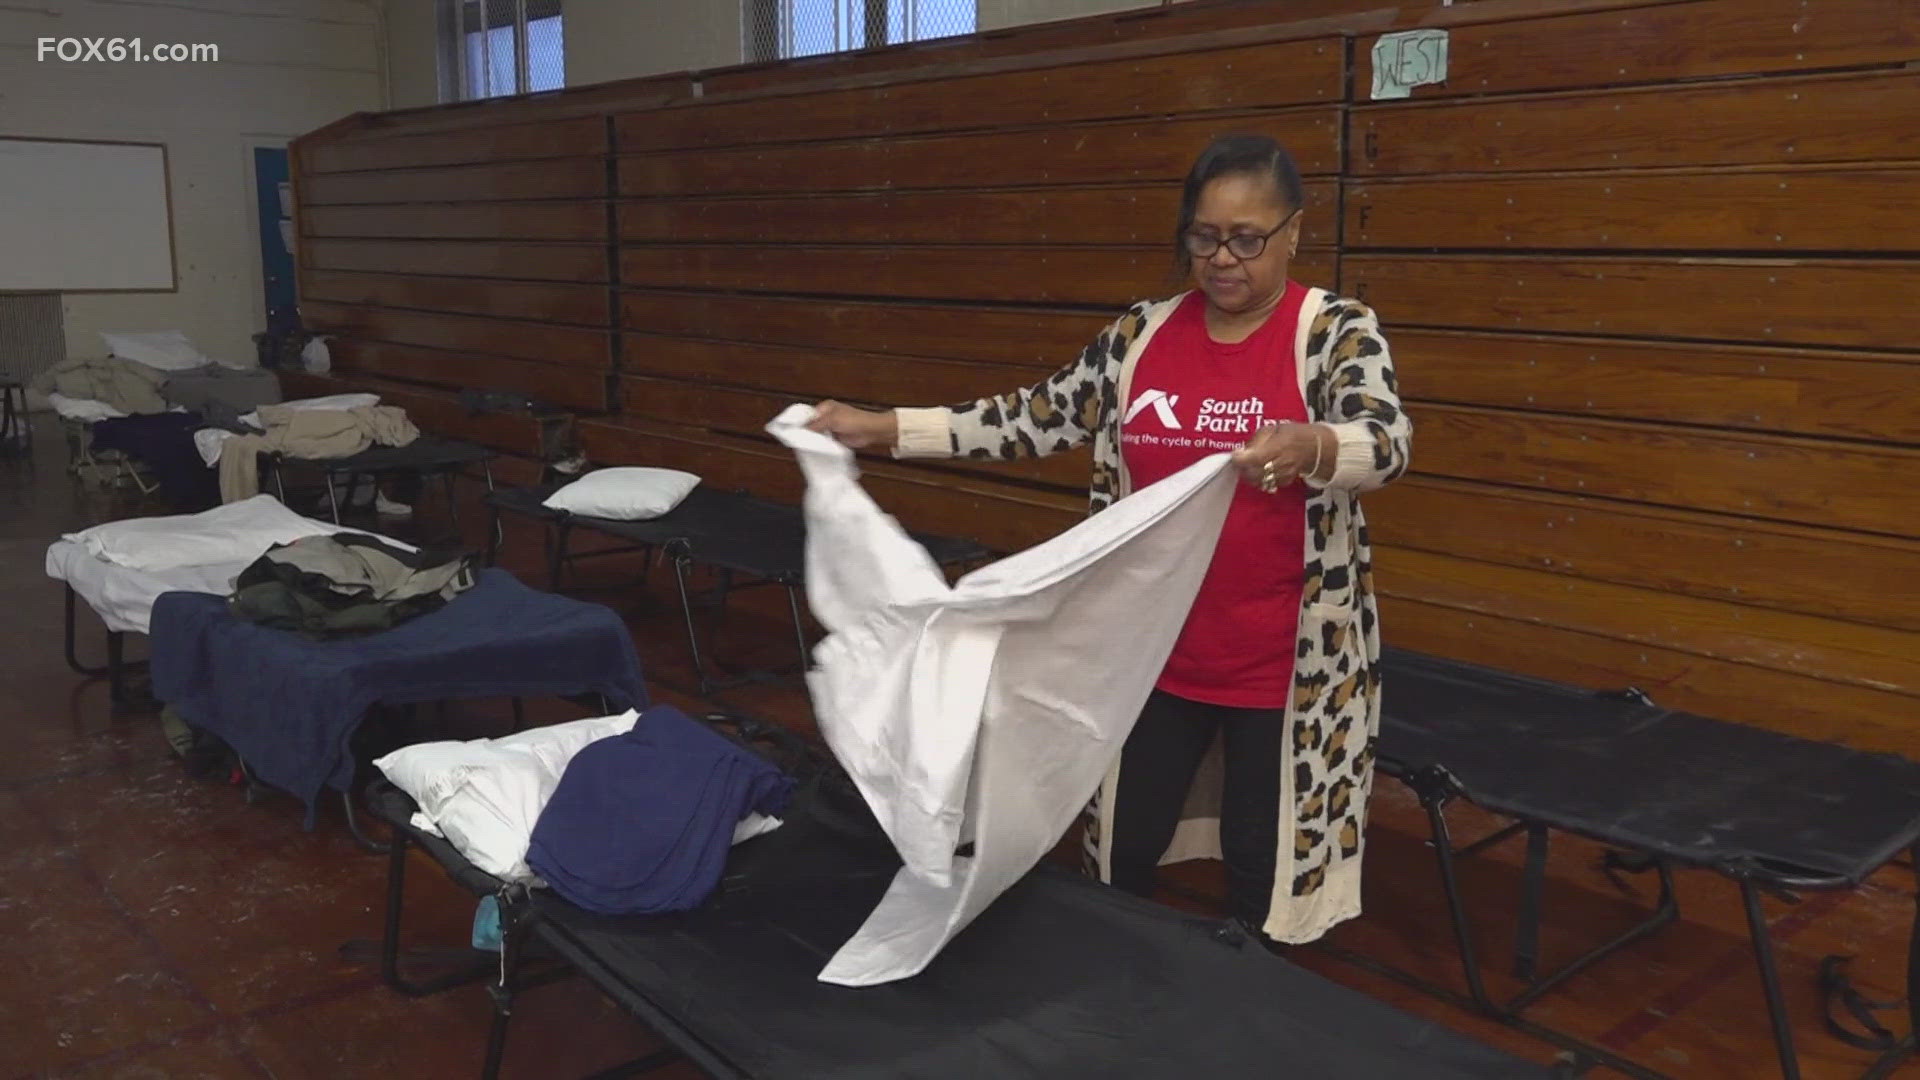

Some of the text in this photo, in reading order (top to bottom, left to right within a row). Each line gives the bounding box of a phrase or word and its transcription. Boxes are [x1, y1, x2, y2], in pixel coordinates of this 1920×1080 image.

[1376, 35, 1445, 92] WEST
[1360, 206, 1373, 229] F
[1200, 397, 1264, 415] South
[1195, 415, 1249, 432] Park
[1141, 433, 1159, 444] the
[1161, 436, 1191, 448] cycle
[1194, 438, 1207, 448] of
